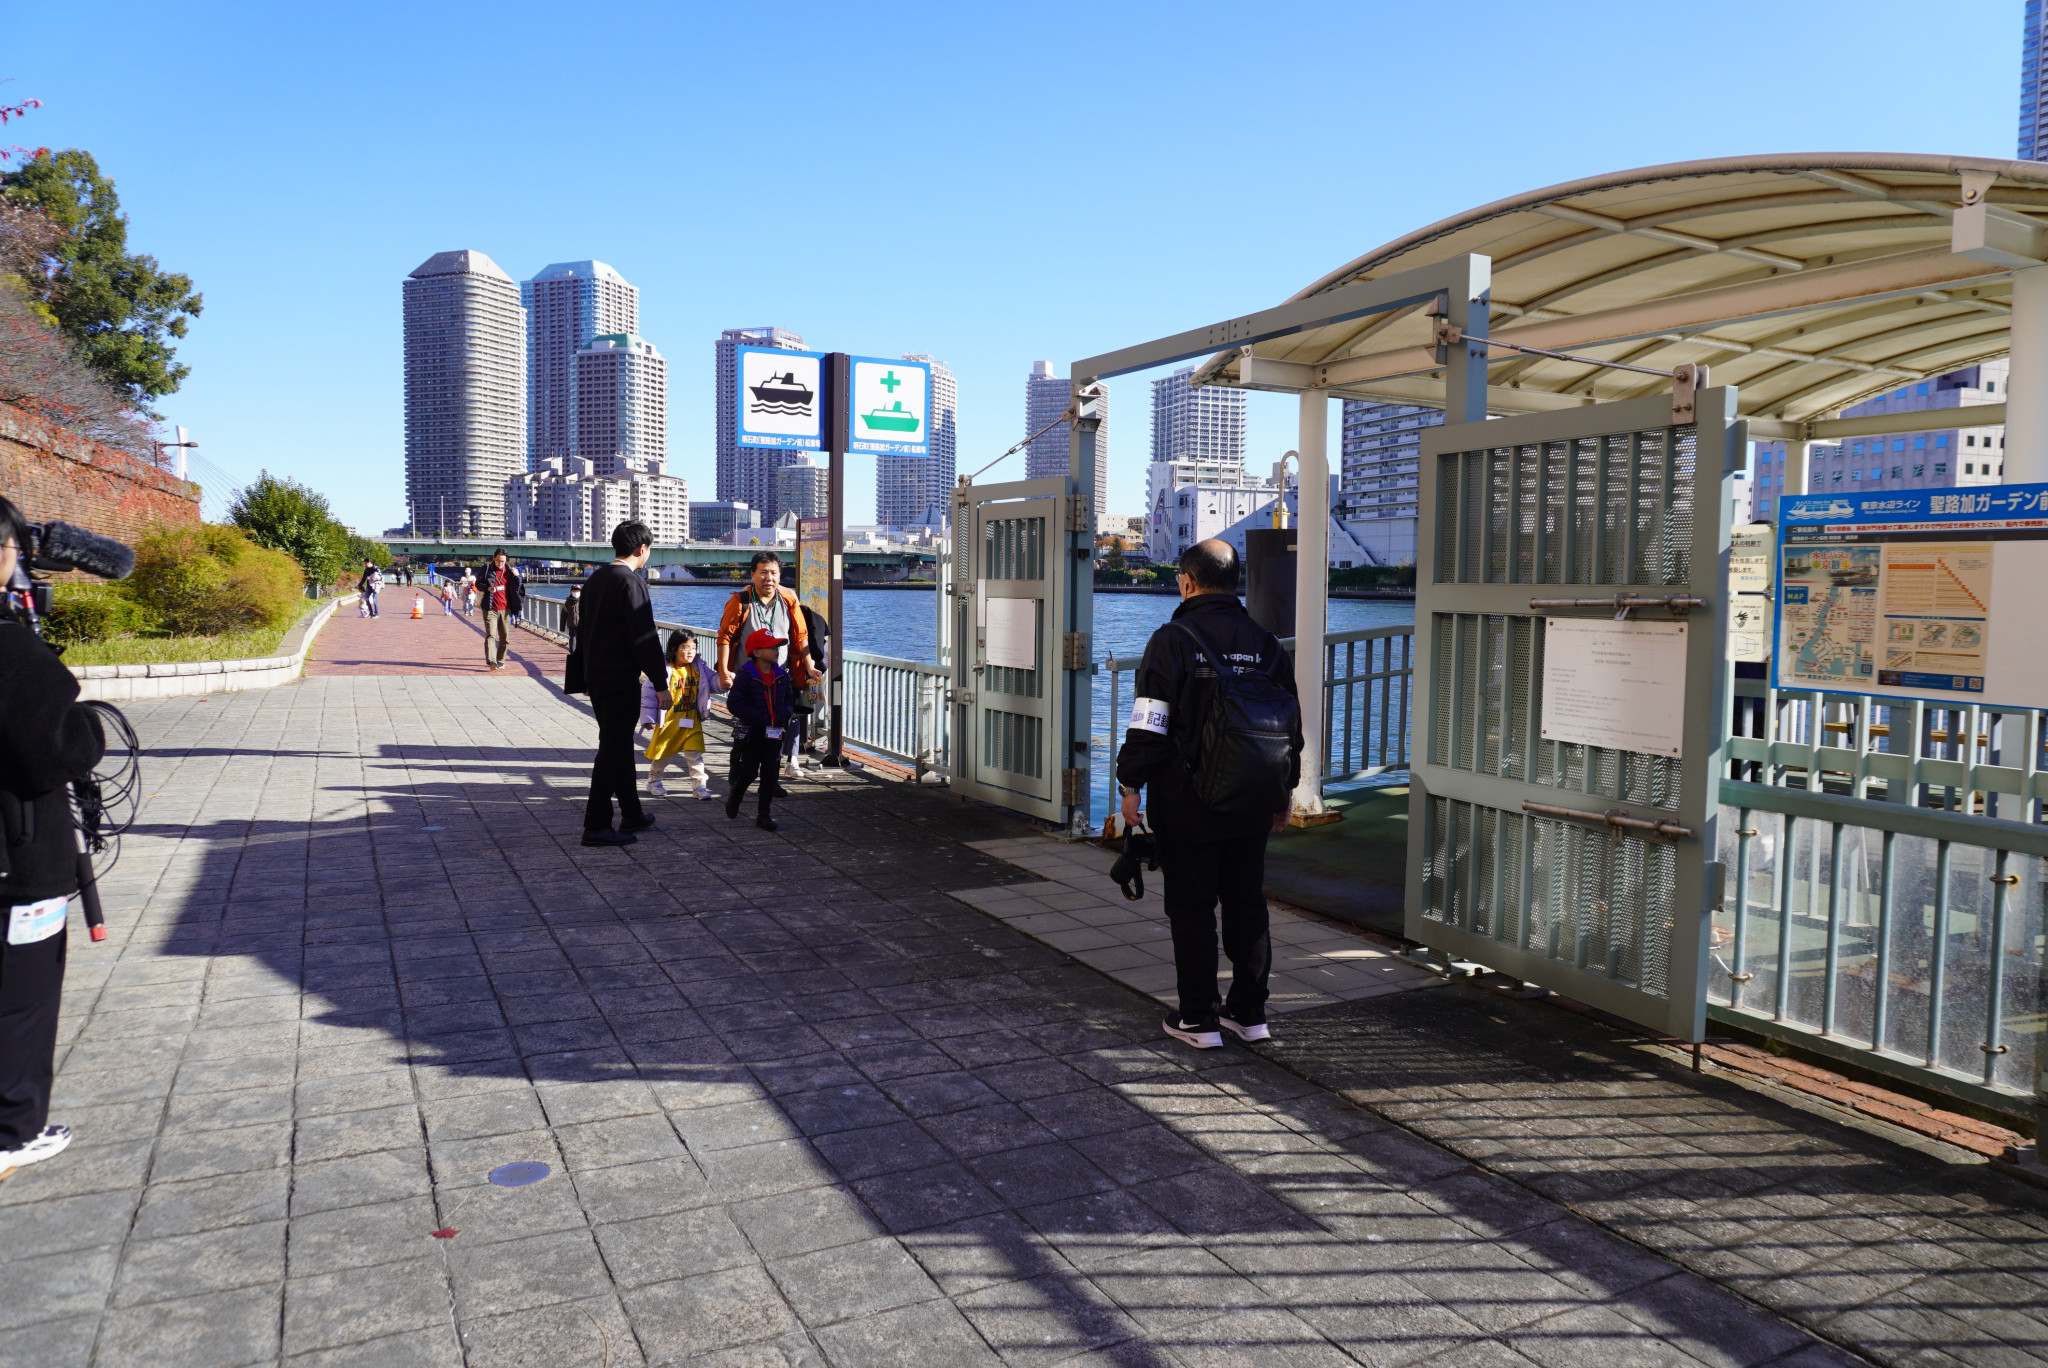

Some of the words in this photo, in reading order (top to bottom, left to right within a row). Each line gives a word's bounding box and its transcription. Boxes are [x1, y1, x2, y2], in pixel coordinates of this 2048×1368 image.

[1860, 500, 1921, 510] 東京水辺ライン
